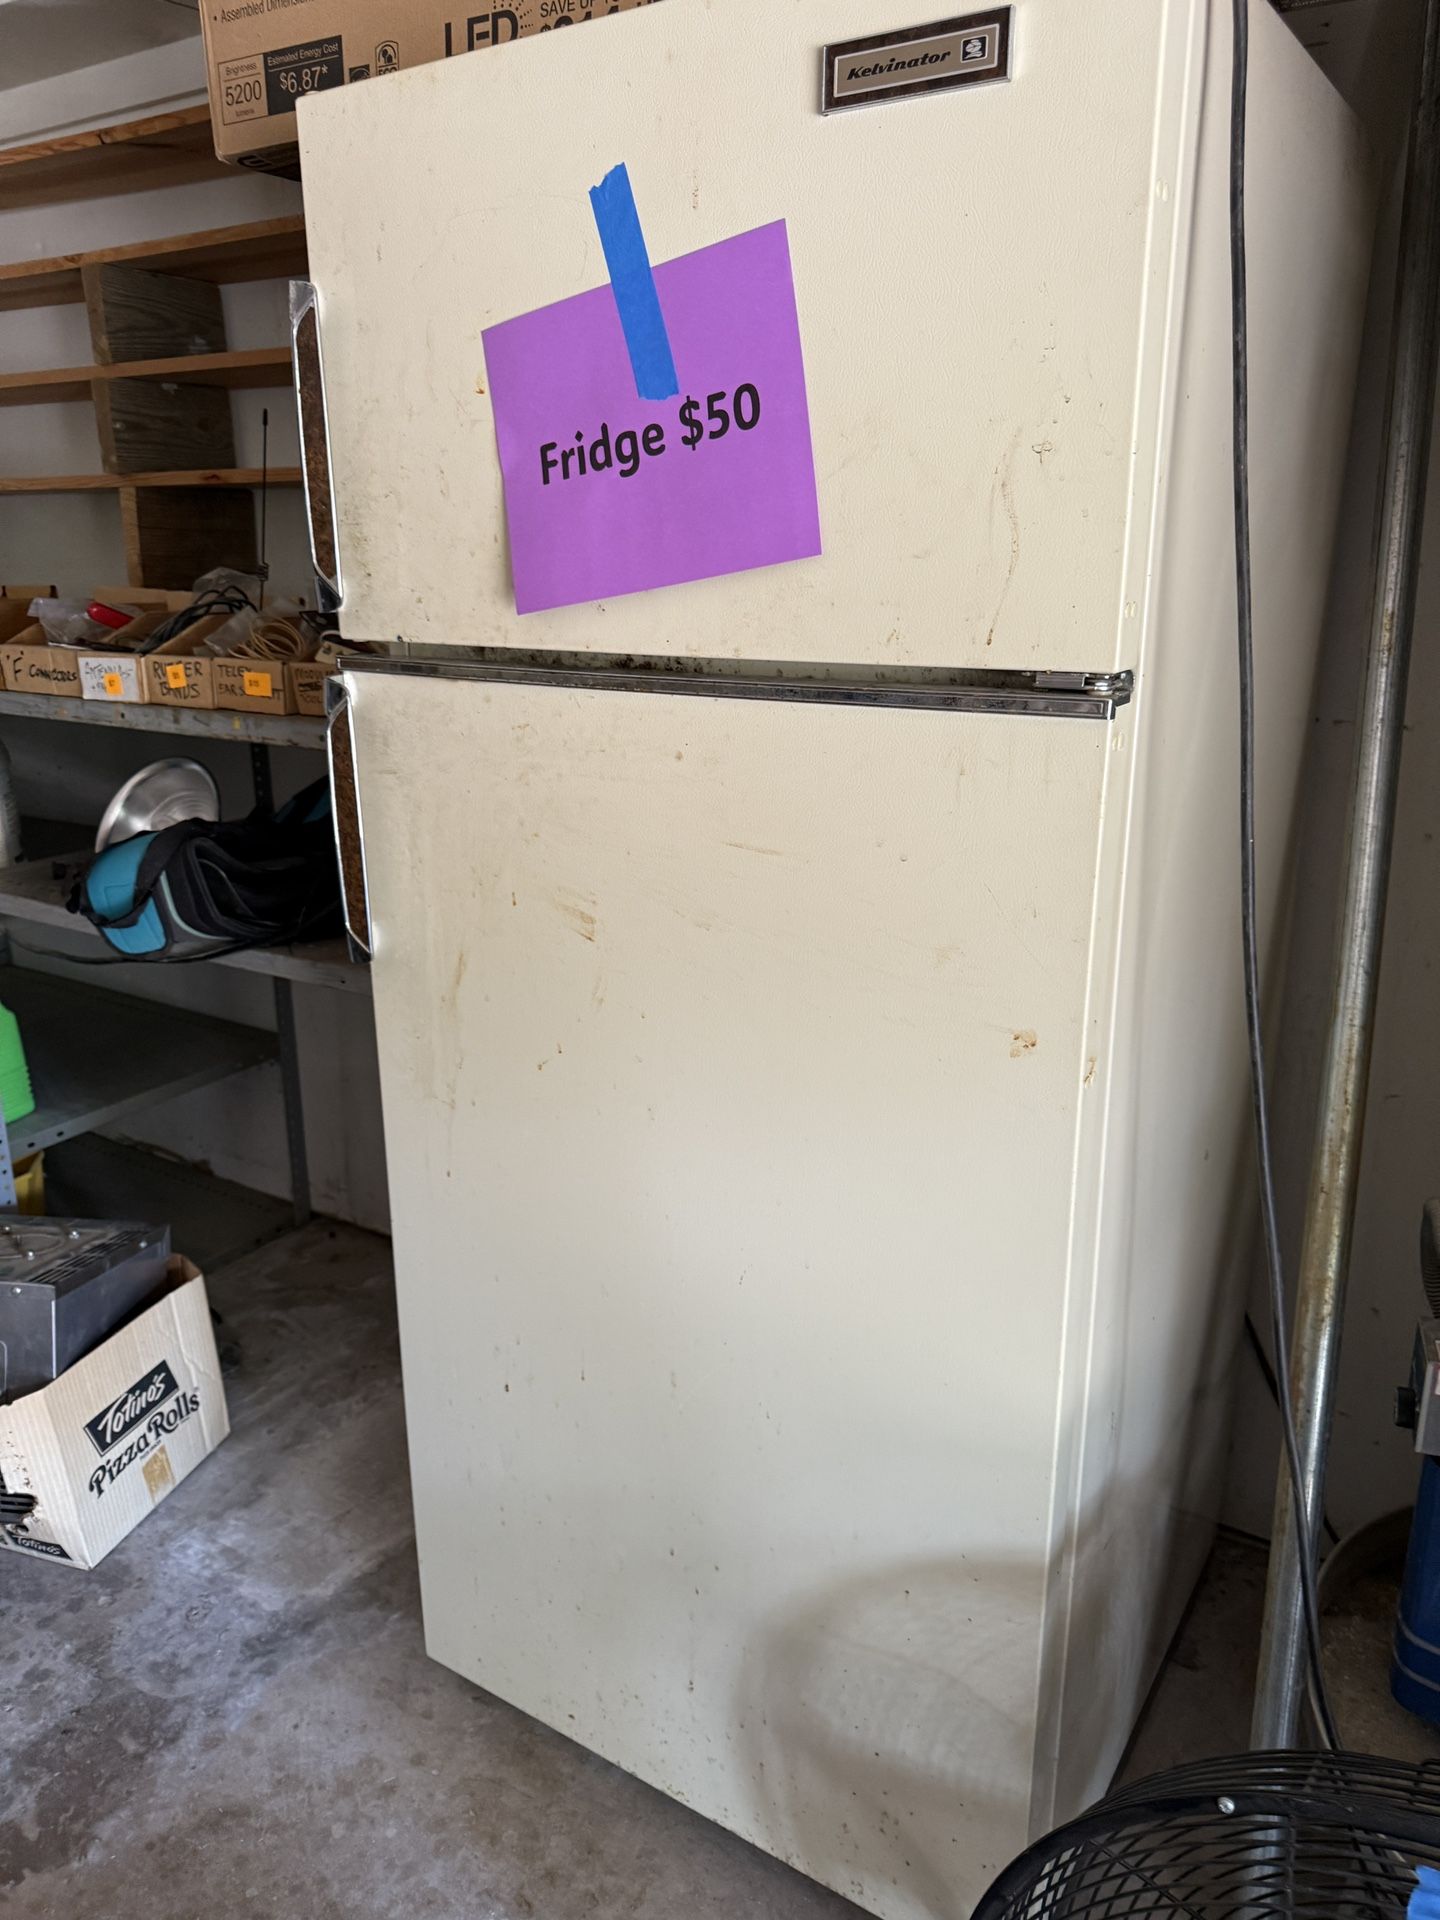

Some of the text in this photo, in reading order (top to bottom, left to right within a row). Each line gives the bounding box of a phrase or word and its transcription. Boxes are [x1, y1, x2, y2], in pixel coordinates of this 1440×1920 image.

[221, 3, 265, 23] Assembled
[540, 0, 576, 18] SAVE
[445, 9, 519, 58] LED
[267, 42, 339, 67] Estimated Energy Cost
[847, 51, 951, 81] Kelvinator
[225, 62, 258, 76] Brightness
[225, 80, 262, 106] 5200
[540, 382, 761, 485] Fridge $50
[152, 660, 204, 680] RUER
[97, 1372, 166, 1444] Totino's
[88, 1391, 200, 1500] Pizza Rolls
[12, 1535, 61, 1555] Totino's
